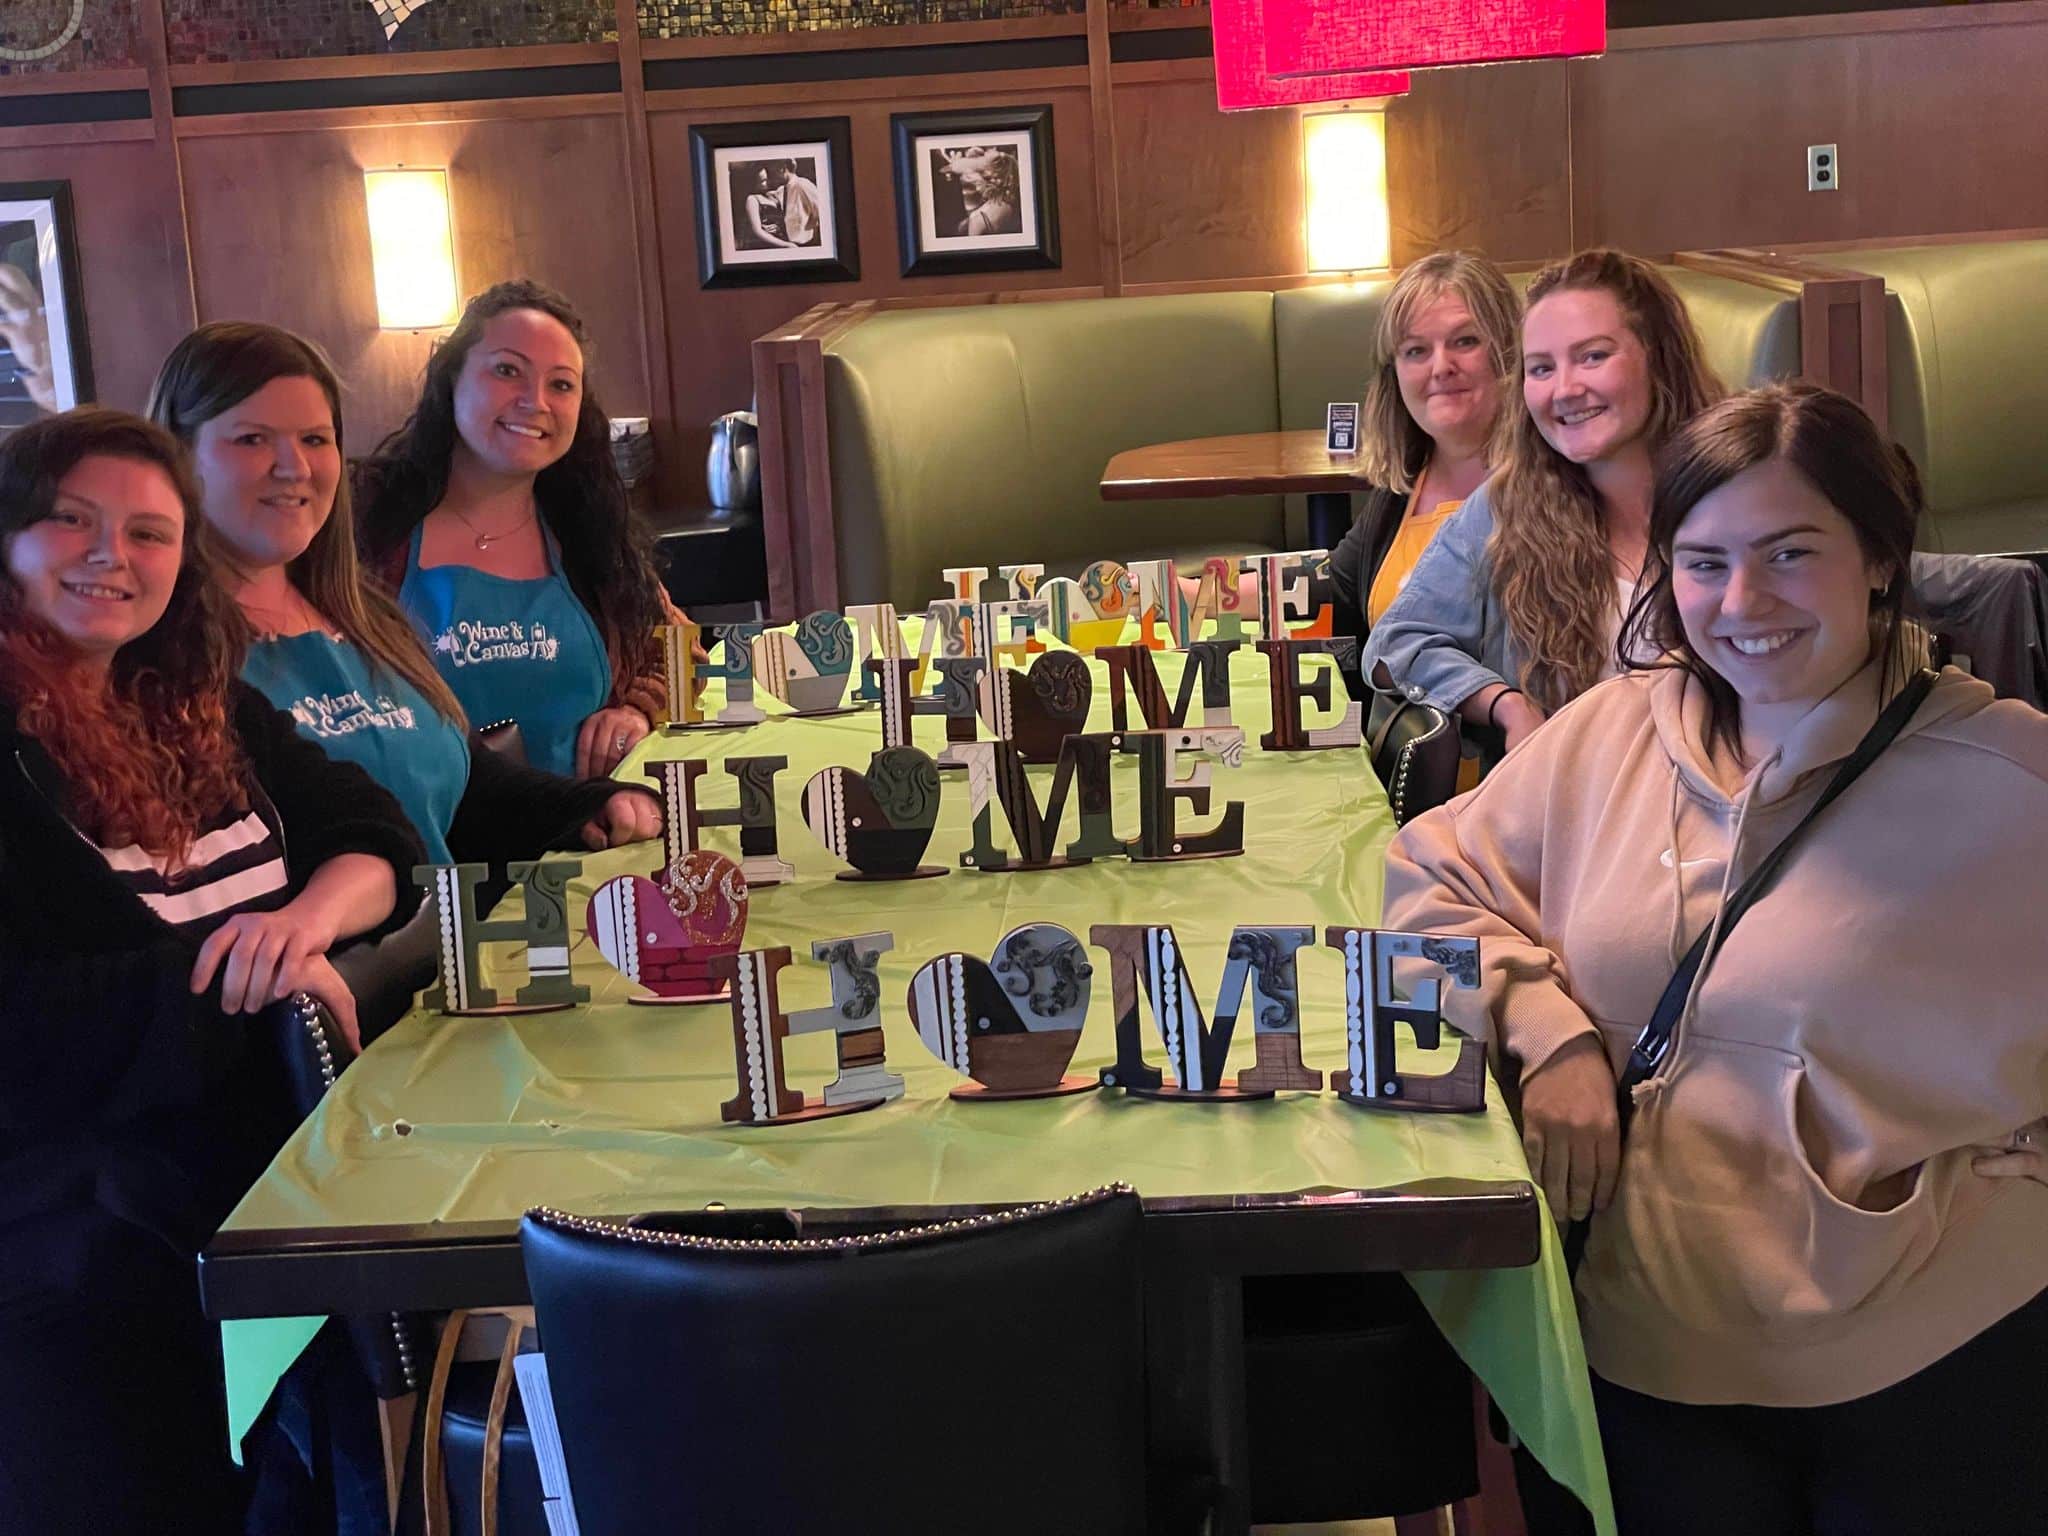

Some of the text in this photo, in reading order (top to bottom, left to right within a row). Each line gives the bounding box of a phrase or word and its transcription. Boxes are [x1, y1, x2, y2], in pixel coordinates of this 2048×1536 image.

[459, 620, 524, 643] Wine &
[467, 639, 529, 665] Canvas
